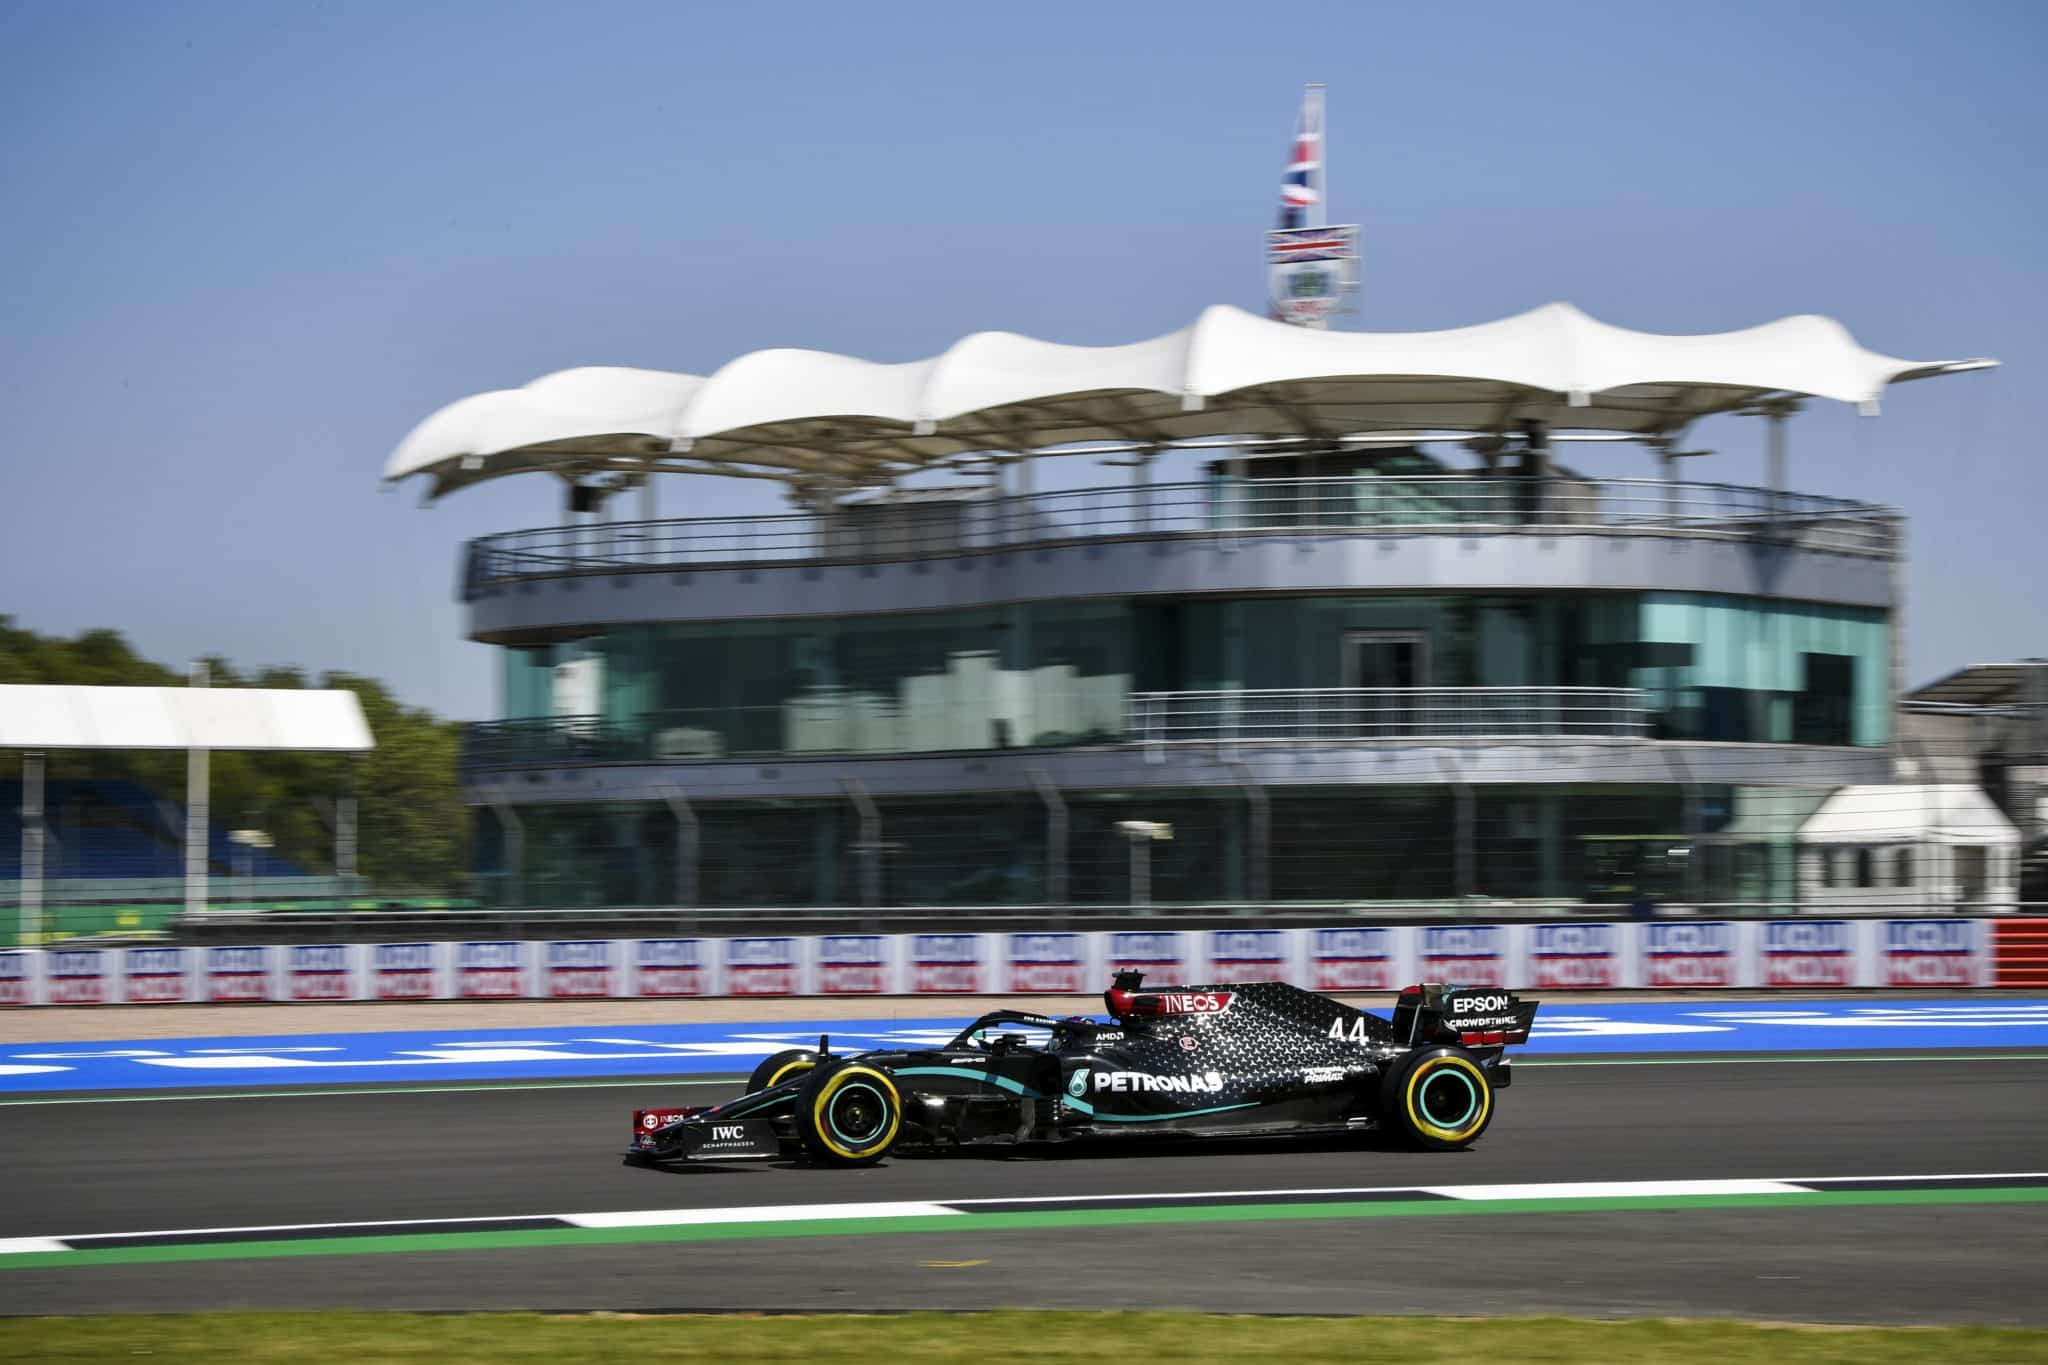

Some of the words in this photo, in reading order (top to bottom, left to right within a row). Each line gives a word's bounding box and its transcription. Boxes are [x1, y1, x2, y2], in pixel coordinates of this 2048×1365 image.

[1165, 994, 1220, 1013] INEOS
[1453, 995, 1508, 1013] EPSON
[1328, 1016, 1370, 1046] 44
[1449, 1016, 1517, 1028] CROWDSTRIKE
[1096, 1032, 1117, 1041] AMD
[1094, 1071, 1223, 1093] PETRONAS
[712, 1126, 744, 1140] IWC
